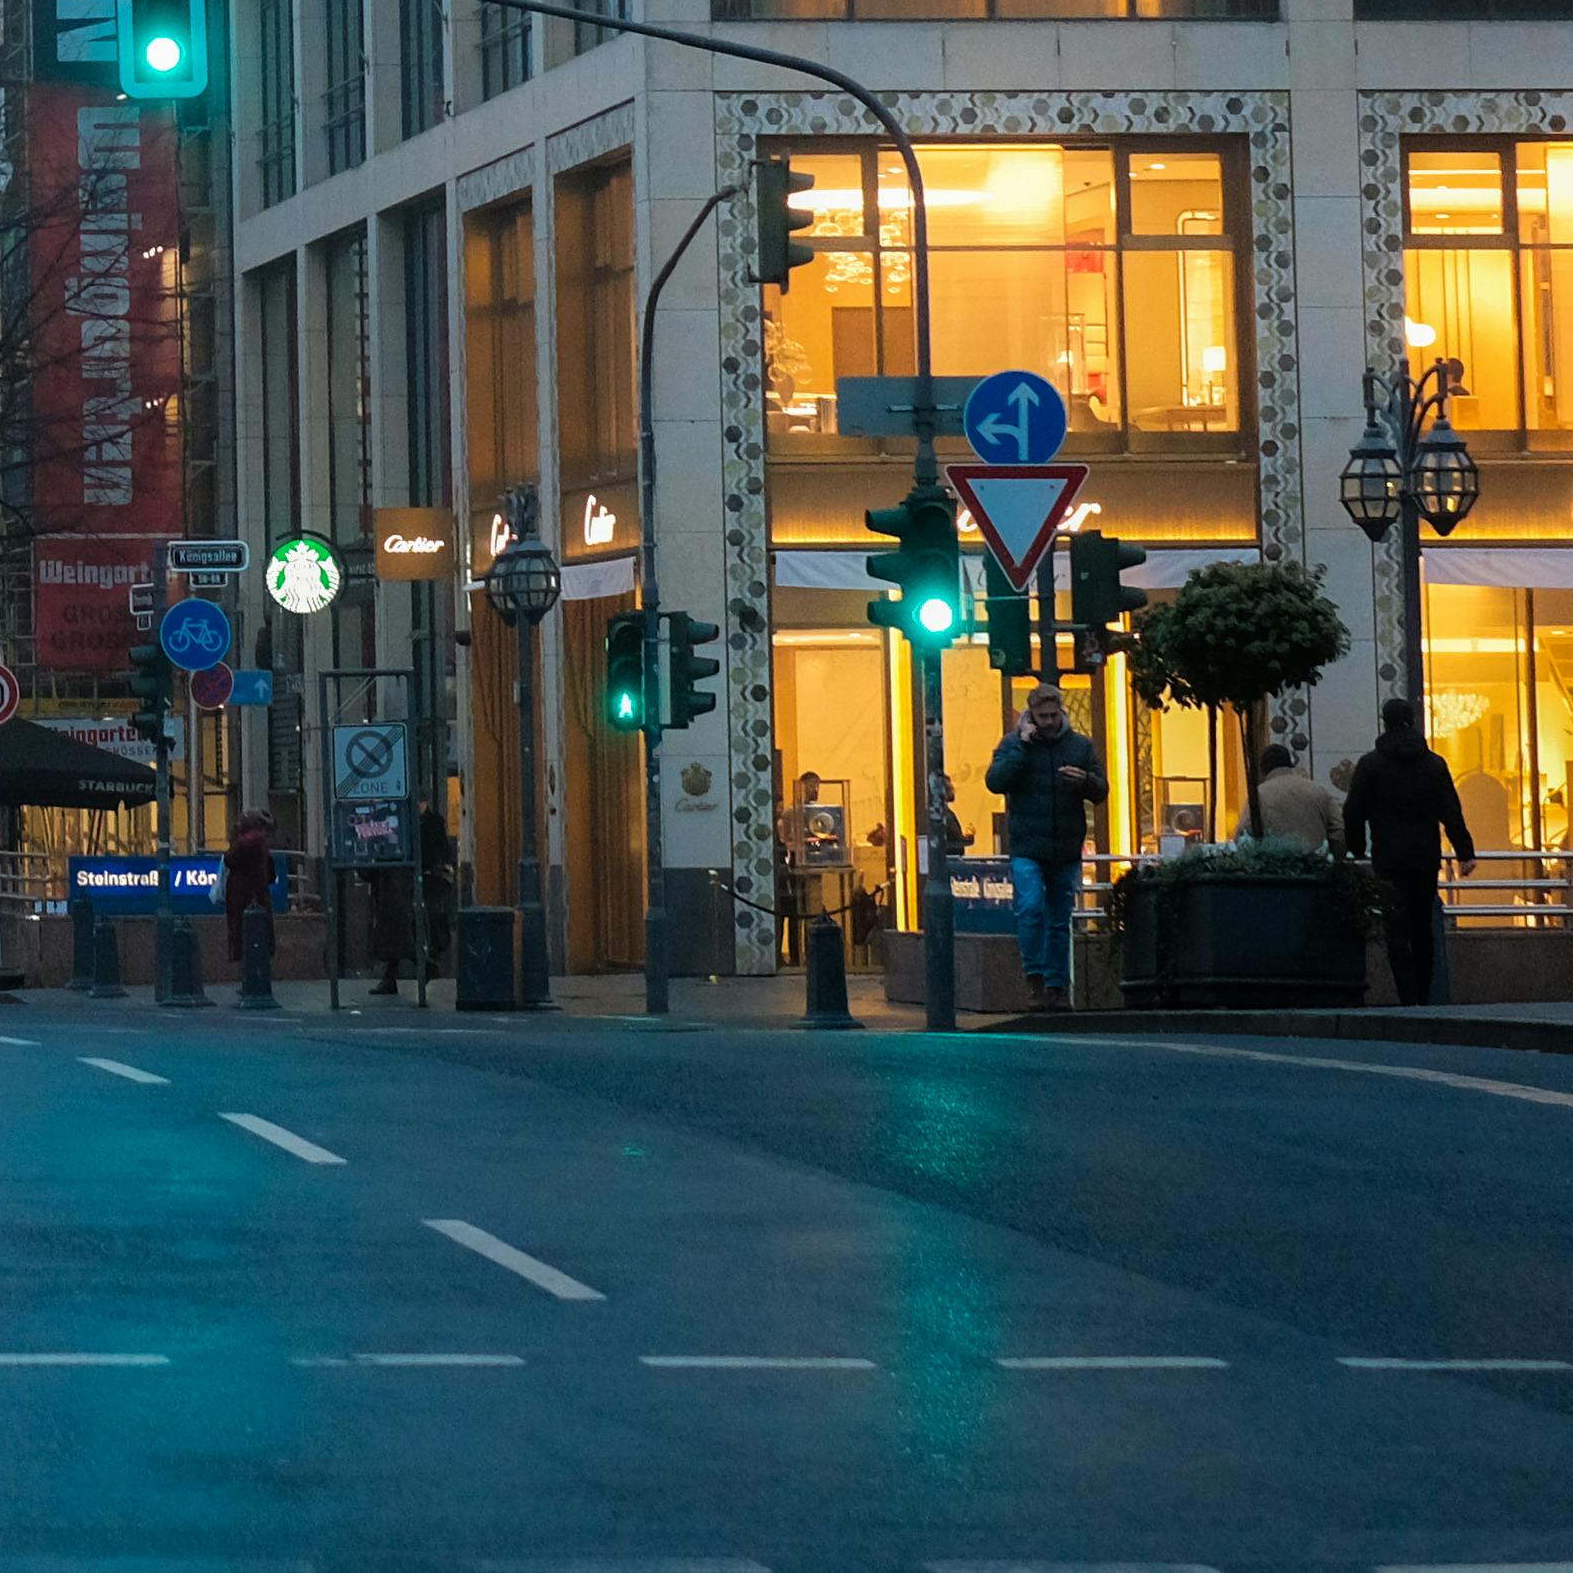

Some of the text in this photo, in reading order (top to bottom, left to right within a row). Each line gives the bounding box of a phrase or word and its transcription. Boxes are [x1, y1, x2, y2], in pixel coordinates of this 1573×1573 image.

[64, 106, 143, 506] Weingarten
[383, 534, 445, 554] Cartier
[178, 549, 238, 565] Königsallee
[39, 559, 154, 590] Weingart
[78, 779, 155, 795] STARBUCK
[354, 782, 388, 795] ZONE
[77, 870, 161, 887] Steinstraß
[186, 870, 218, 887] Kön
